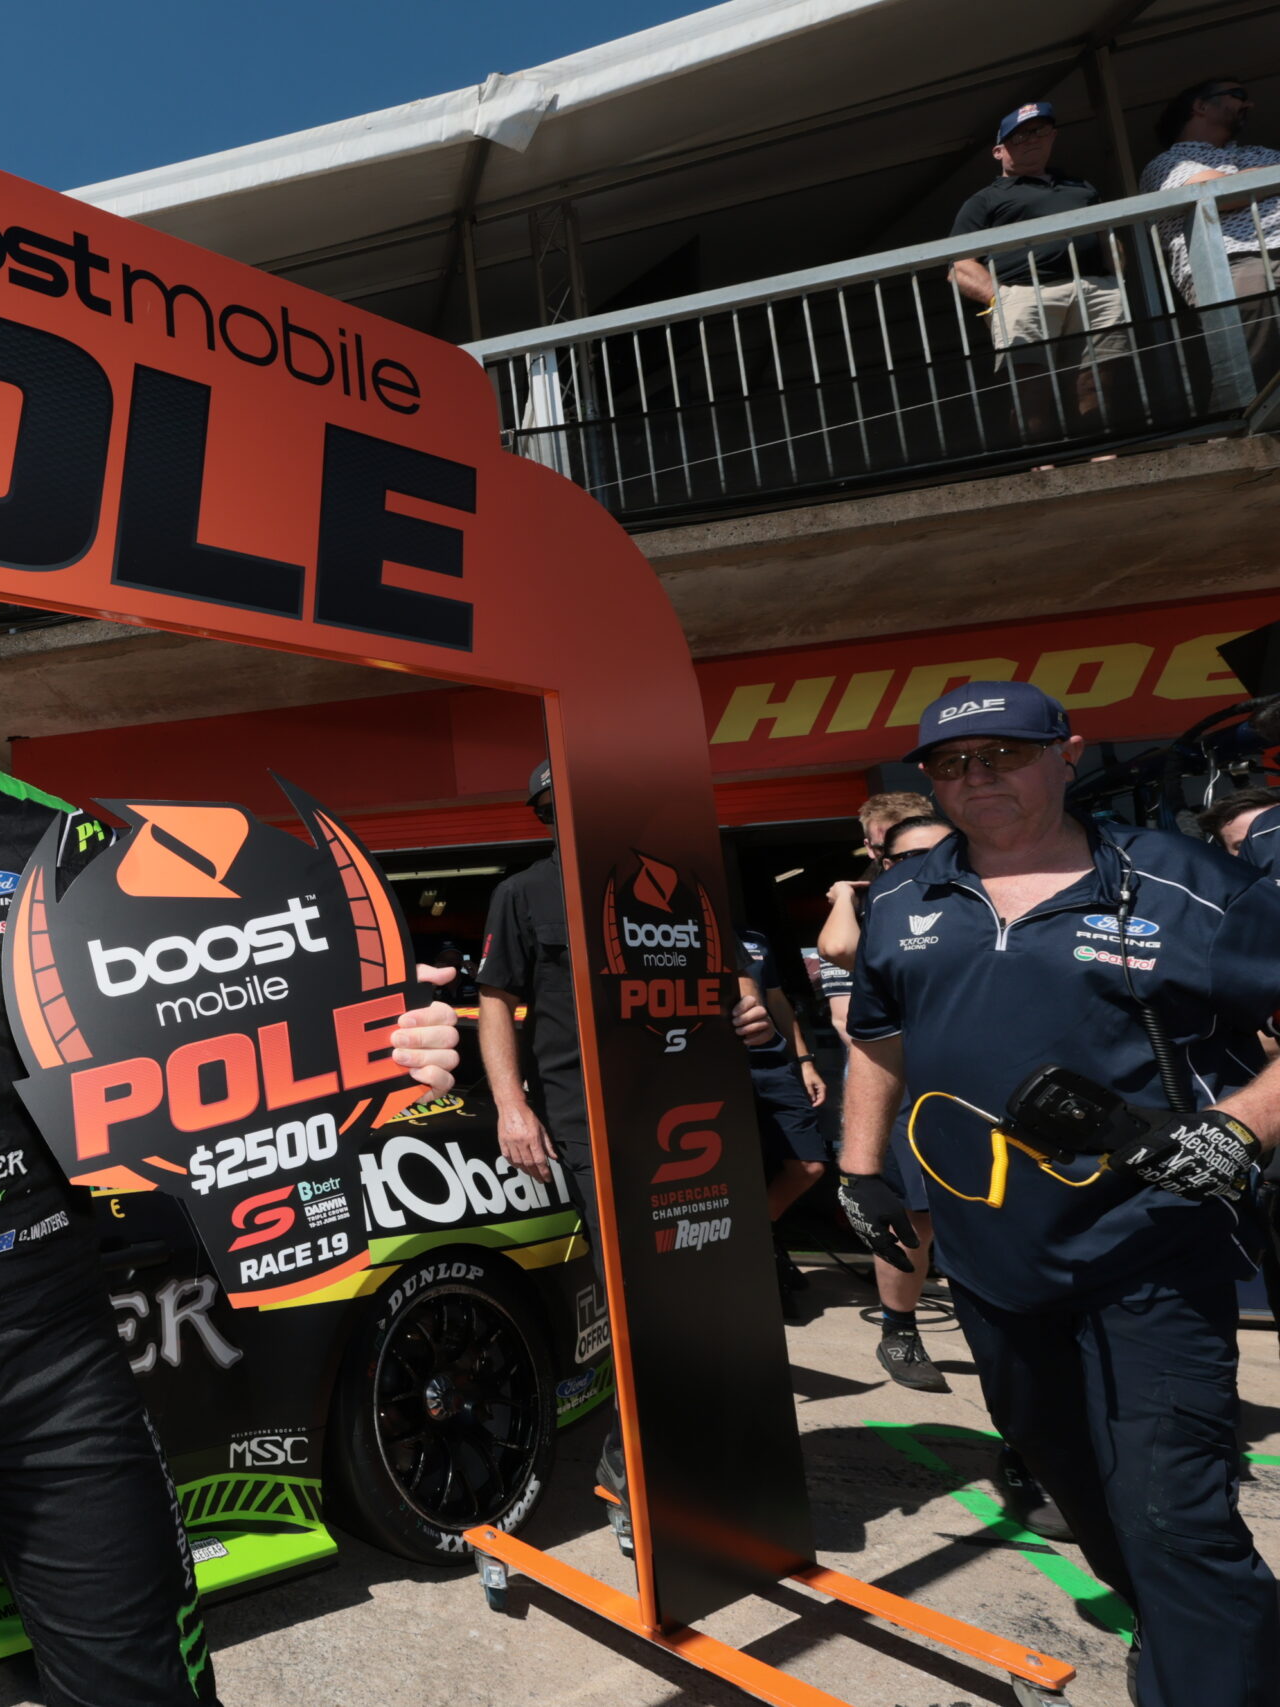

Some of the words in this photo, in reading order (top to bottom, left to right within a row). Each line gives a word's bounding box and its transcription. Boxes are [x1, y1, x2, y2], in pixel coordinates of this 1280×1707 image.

[87, 897, 329, 998] boost
[622, 917, 701, 949] boost
[1076, 931, 1161, 949] RACING
[643, 952, 687, 967] mobile
[155, 976, 290, 1027] mobile
[621, 977, 723, 1020] POLE
[70, 992, 420, 1161] POLE
[189, 1112, 338, 1195] $2500
[304, 1196, 347, 1217] DARWIN
[650, 1184, 729, 1208] SUPERCARS
[652, 1198, 730, 1221] CHAMPIONSHIP
[675, 1217, 732, 1251] Repco
[240, 1245, 313, 1284] RACE
[318, 1231, 349, 1262] 19
[387, 1262, 485, 1317] DUNLOP
[229, 1435, 309, 1469] MSC
